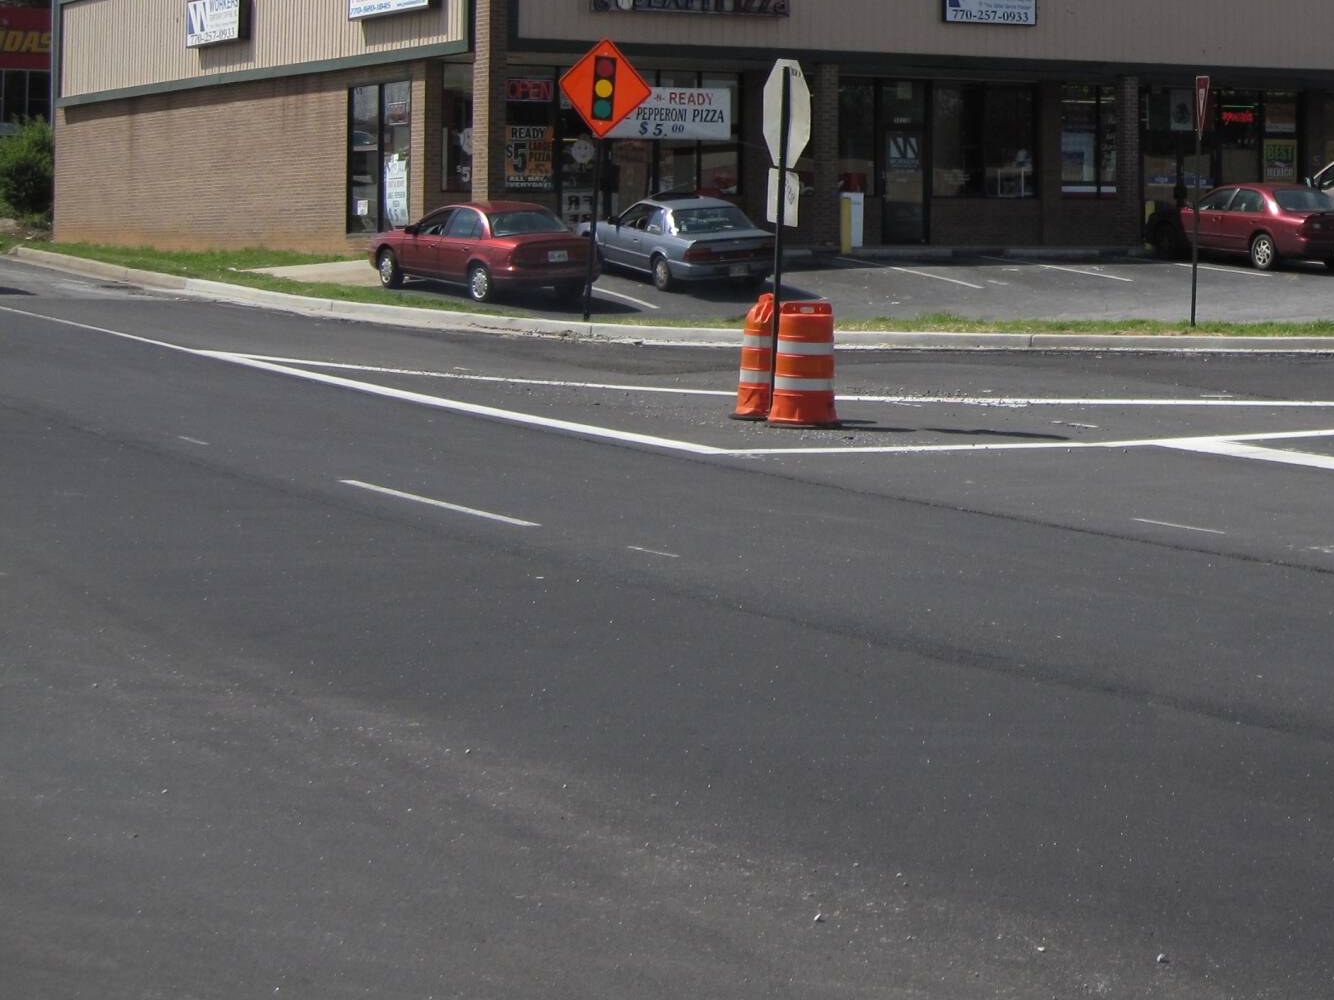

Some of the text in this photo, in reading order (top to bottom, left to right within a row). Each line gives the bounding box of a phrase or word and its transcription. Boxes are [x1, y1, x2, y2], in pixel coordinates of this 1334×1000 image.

[952, 9, 1029, 23] 770-257-0933
[507, 80, 551, 100] OPEN
[669, 92, 714, 106] READY
[636, 107, 725, 123] PEPPERONI PIZZA
[511, 127, 546, 140] READY
